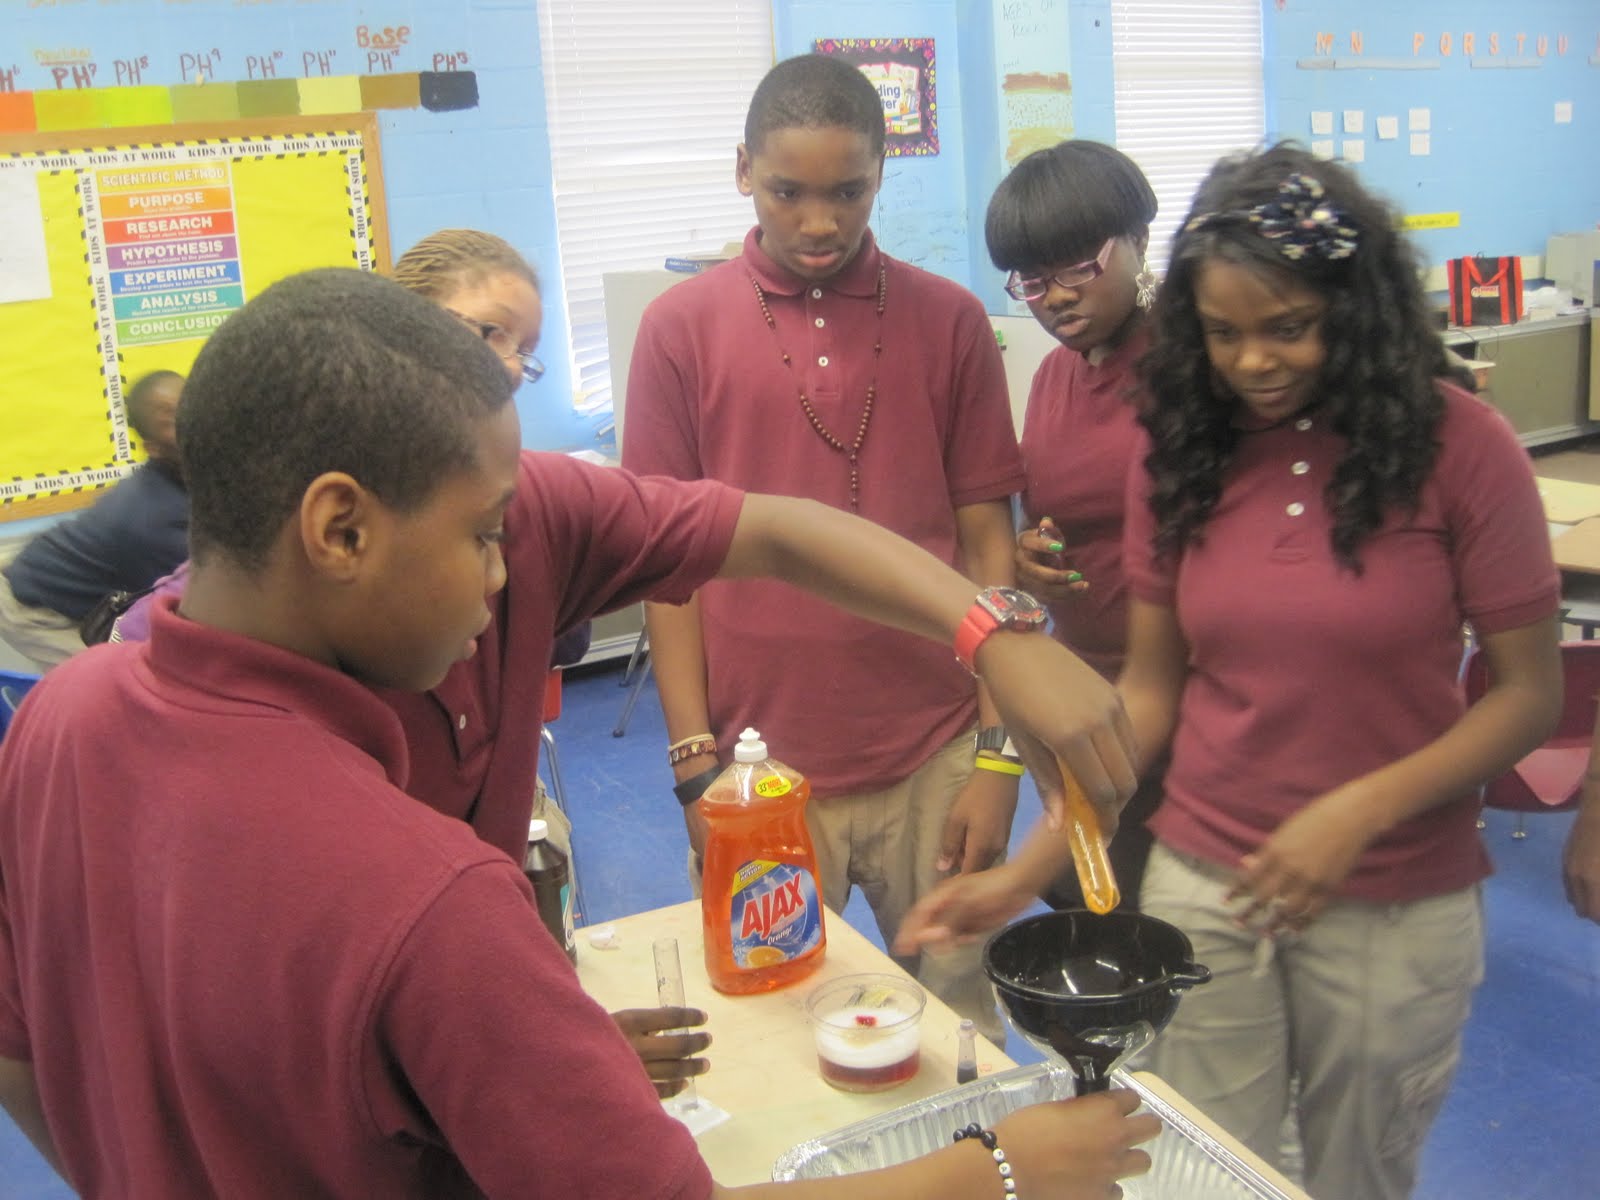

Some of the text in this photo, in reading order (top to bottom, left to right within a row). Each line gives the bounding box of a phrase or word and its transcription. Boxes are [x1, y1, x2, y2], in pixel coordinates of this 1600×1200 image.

[356, 25, 410, 48] Base
[1412, 31, 1424, 56] P
[876, 84, 900, 98] ding
[188, 143, 272, 158] KIDS AT WORK
[283, 141, 310, 151] KIDS
[314, 139, 327, 149] AT
[41, 158, 78, 168] WORK
[89, 150, 177, 165] KIDS AT WORK
[102, 167, 225, 187] SCIENTIFIC METHOD
[128, 191, 205, 208] PURPOSE
[350, 157, 360, 184] KIDS
[356, 206, 366, 238] WORK
[82, 177, 101, 264] KIDS AT WORK
[126, 216, 213, 234] RESEARCH
[121, 240, 224, 260] HYPOTHESIS
[360, 250, 370, 272] KID
[124, 265, 226, 286] EXPERIMENT
[141, 290, 218, 310] ANALYSIS
[96, 277, 115, 362] KIDS AT WORK
[109, 375, 122, 410] WORK
[118, 431, 129, 459] KIDS
[0, 484, 22, 495] ORK
[34, 469, 122, 490] KIDS AT WORK
[741, 871, 805, 939] AJAX
[767, 925, 794, 946] Orange
